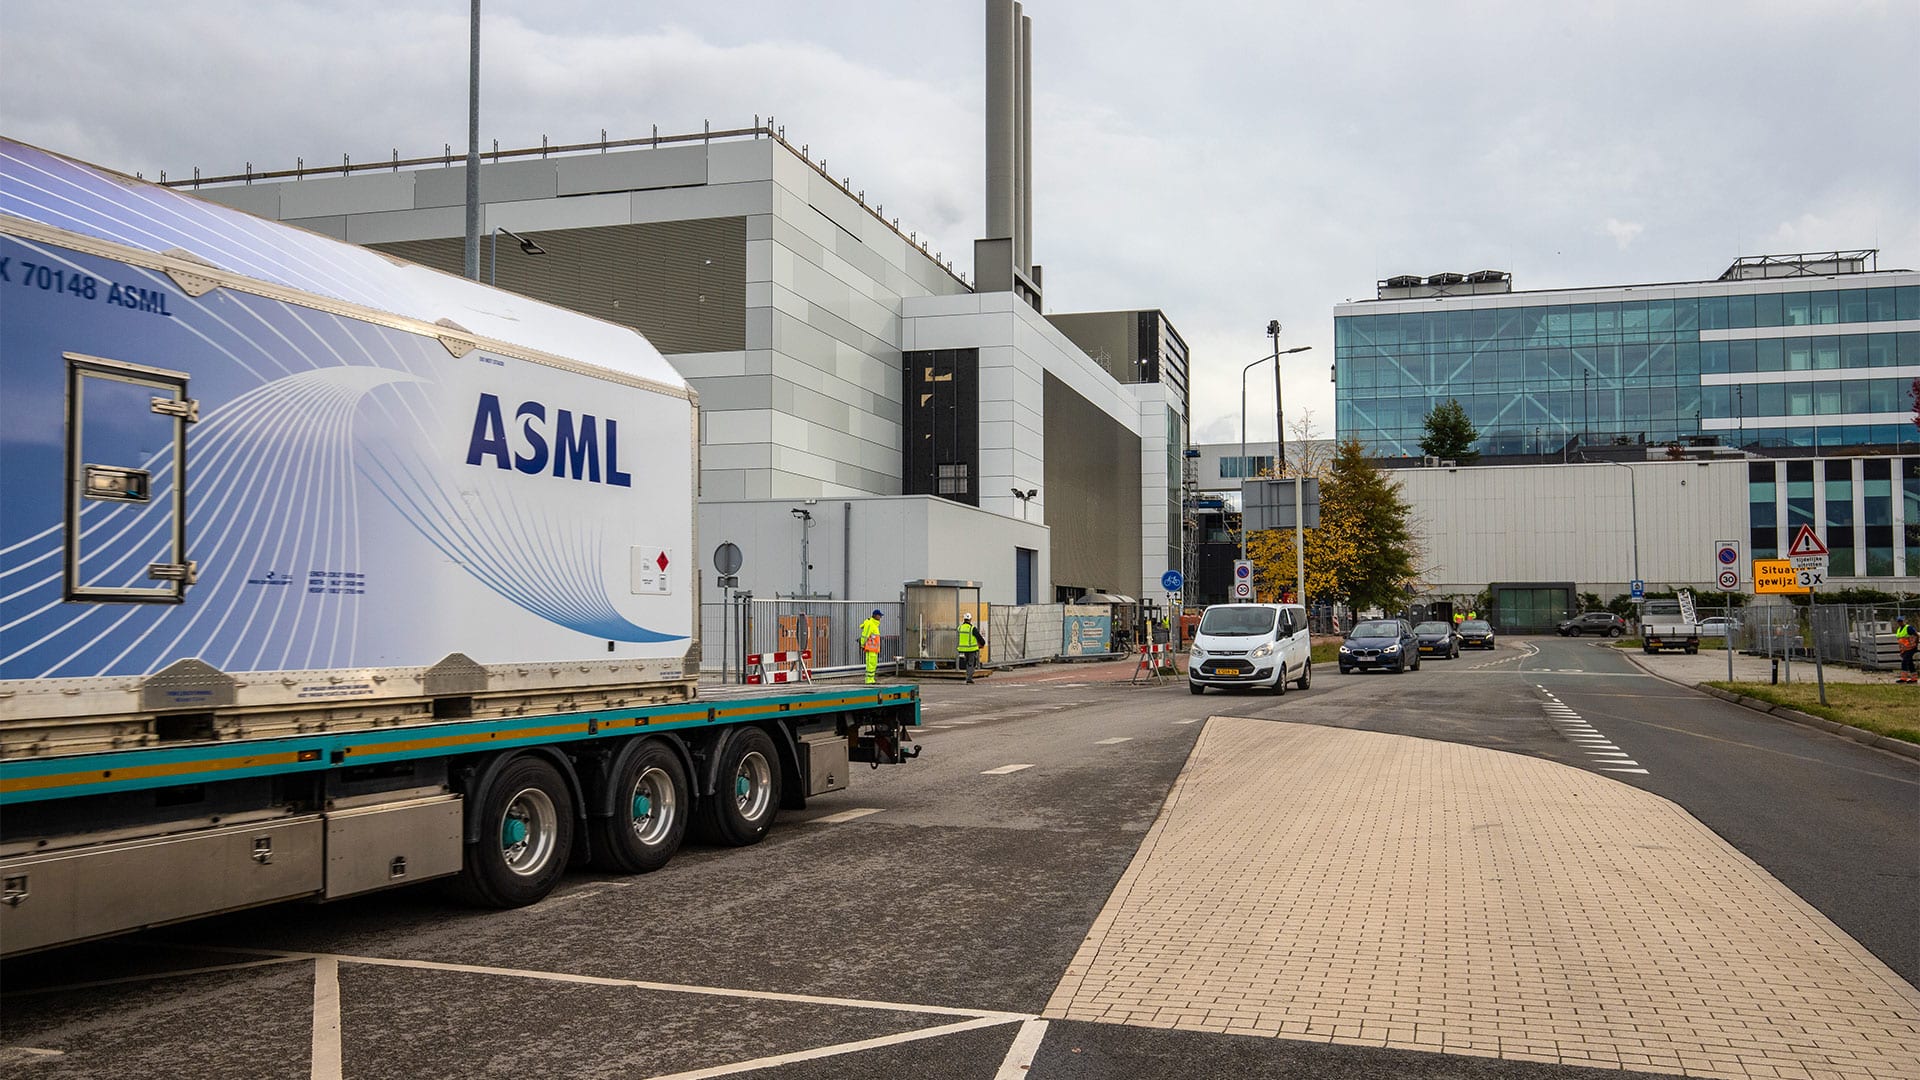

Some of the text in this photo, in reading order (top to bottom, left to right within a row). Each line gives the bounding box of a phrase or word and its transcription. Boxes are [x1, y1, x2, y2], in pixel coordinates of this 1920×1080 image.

[21, 262, 97, 300] 70148
[107, 282, 172, 316] ASML
[466, 392, 632, 488] ASML
